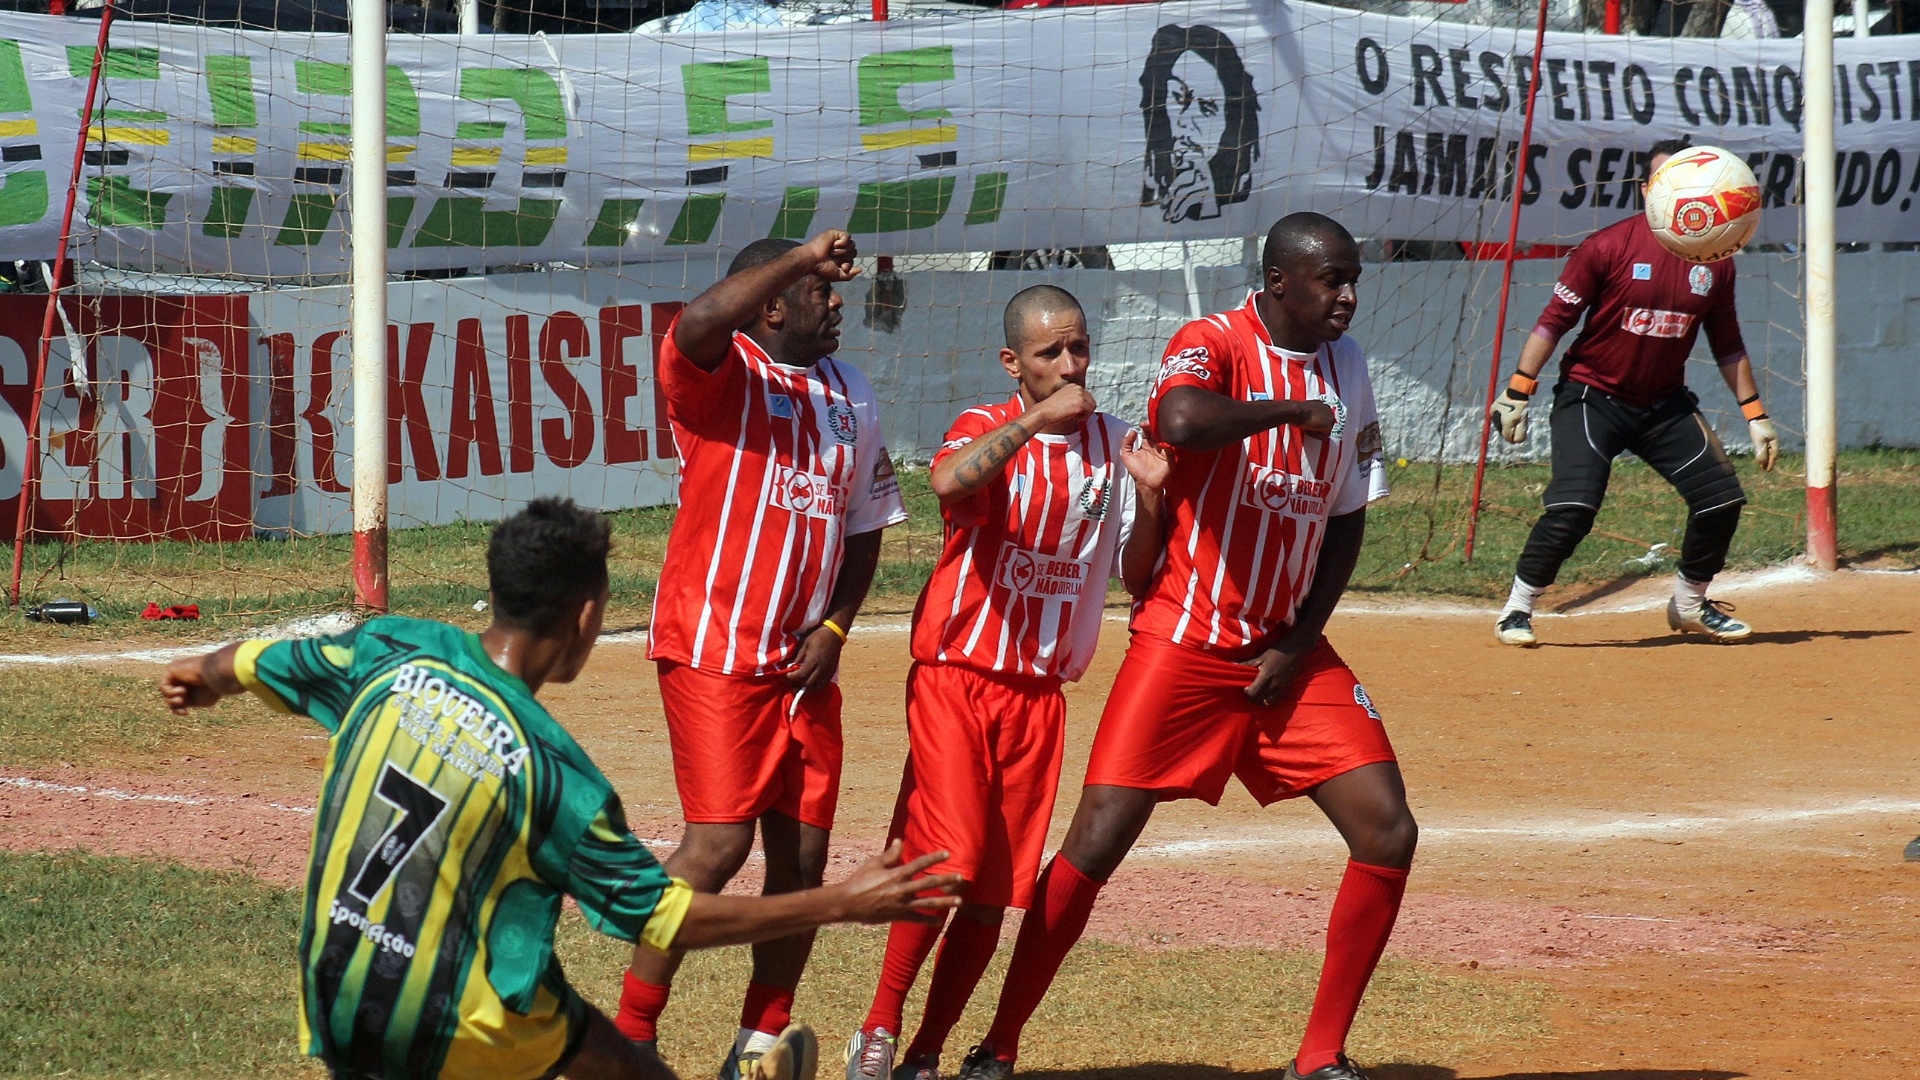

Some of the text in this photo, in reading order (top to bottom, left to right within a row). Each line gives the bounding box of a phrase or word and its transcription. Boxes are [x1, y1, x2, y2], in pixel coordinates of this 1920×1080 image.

[1356, 38, 1389, 95] O
[1410, 44, 1655, 125] RESPEITO
[1365, 125, 1548, 206] JAMAIS
[1560, 147, 1655, 210] SER
[815, 483, 825, 496] SE
[1034, 577, 1082, 596] NÃO DIRIJA
[1036, 563, 1046, 576] SE
[390, 663, 530, 776] BIQUEIRA
[392, 695, 506, 779] FUTEBOL E SAMBA
[399, 716, 485, 783] VILA MARIA
[347, 759, 452, 906] 7
